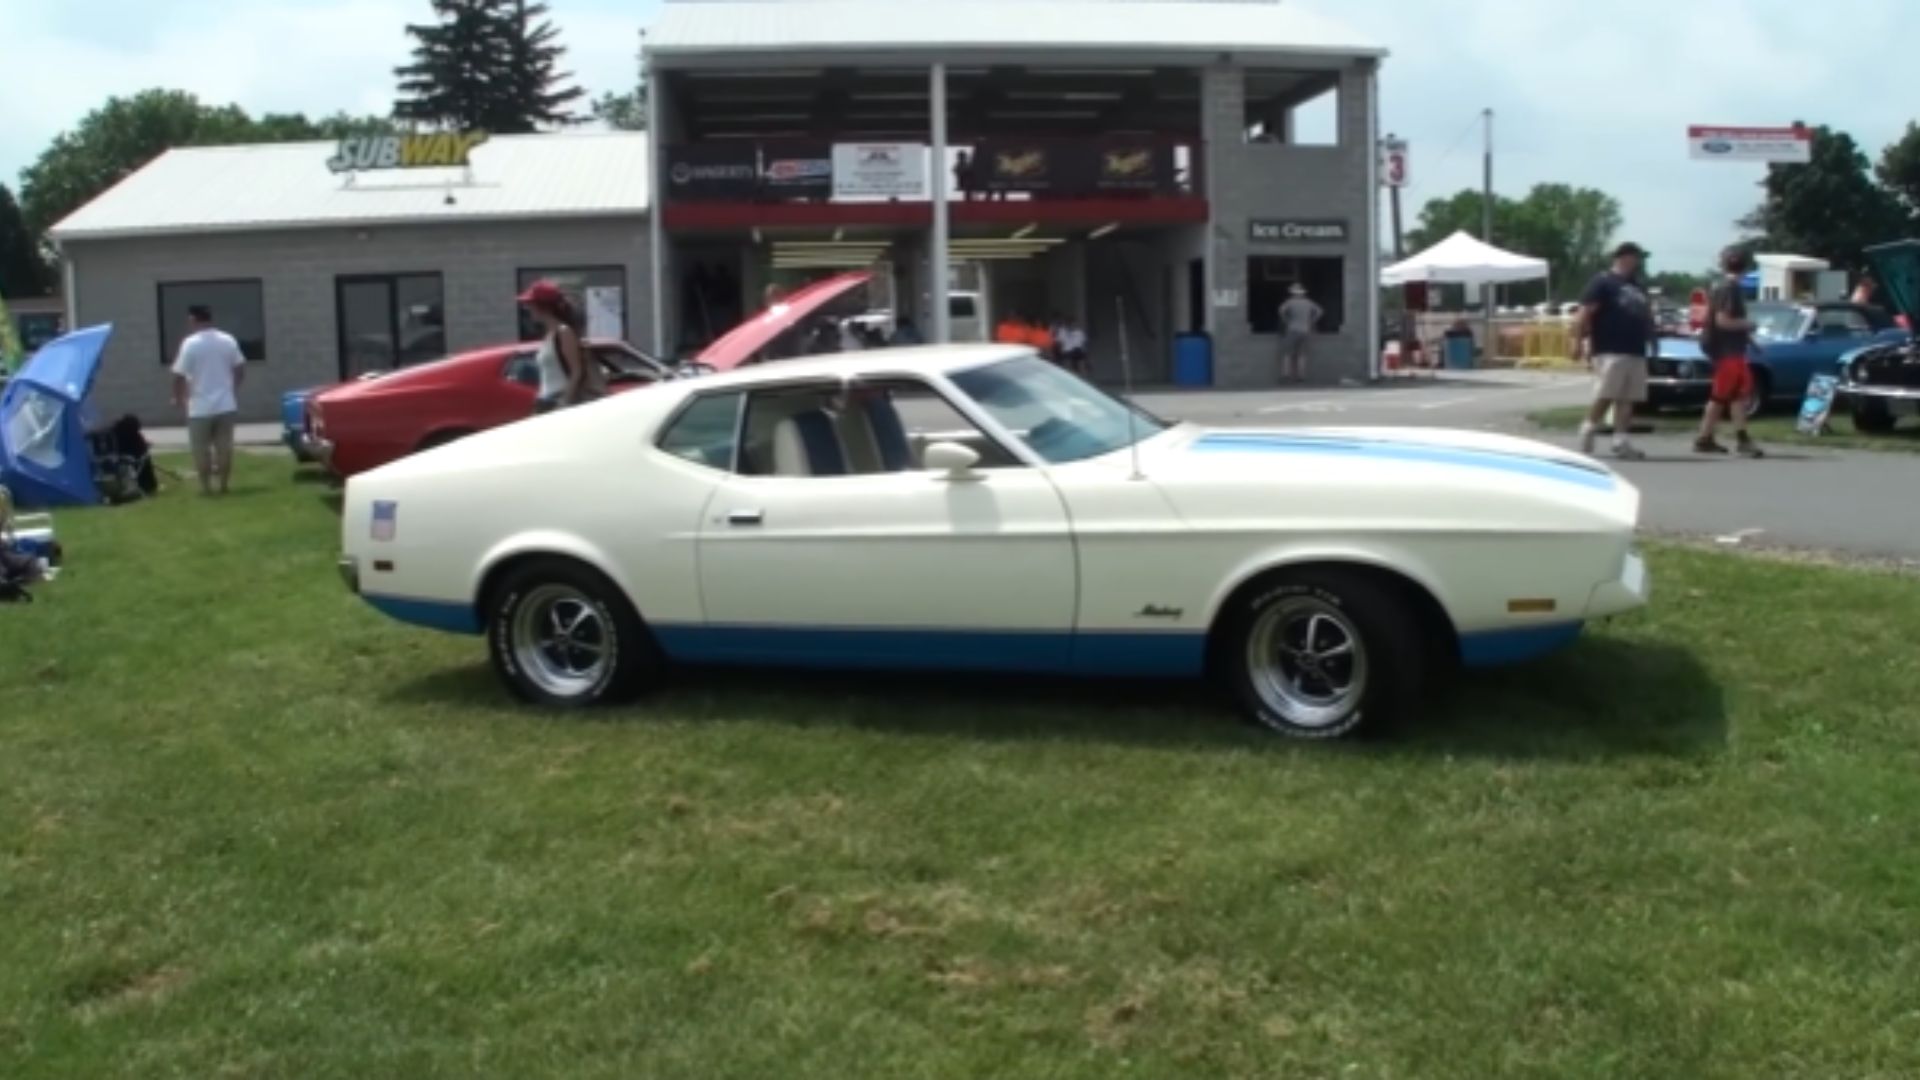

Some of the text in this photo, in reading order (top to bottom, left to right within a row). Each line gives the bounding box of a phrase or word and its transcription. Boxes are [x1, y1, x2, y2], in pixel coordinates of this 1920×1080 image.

[328, 131, 488, 173] SUBWAY
[1389, 154, 1404, 182] 3
[1252, 222, 1343, 239] Ice Cream
